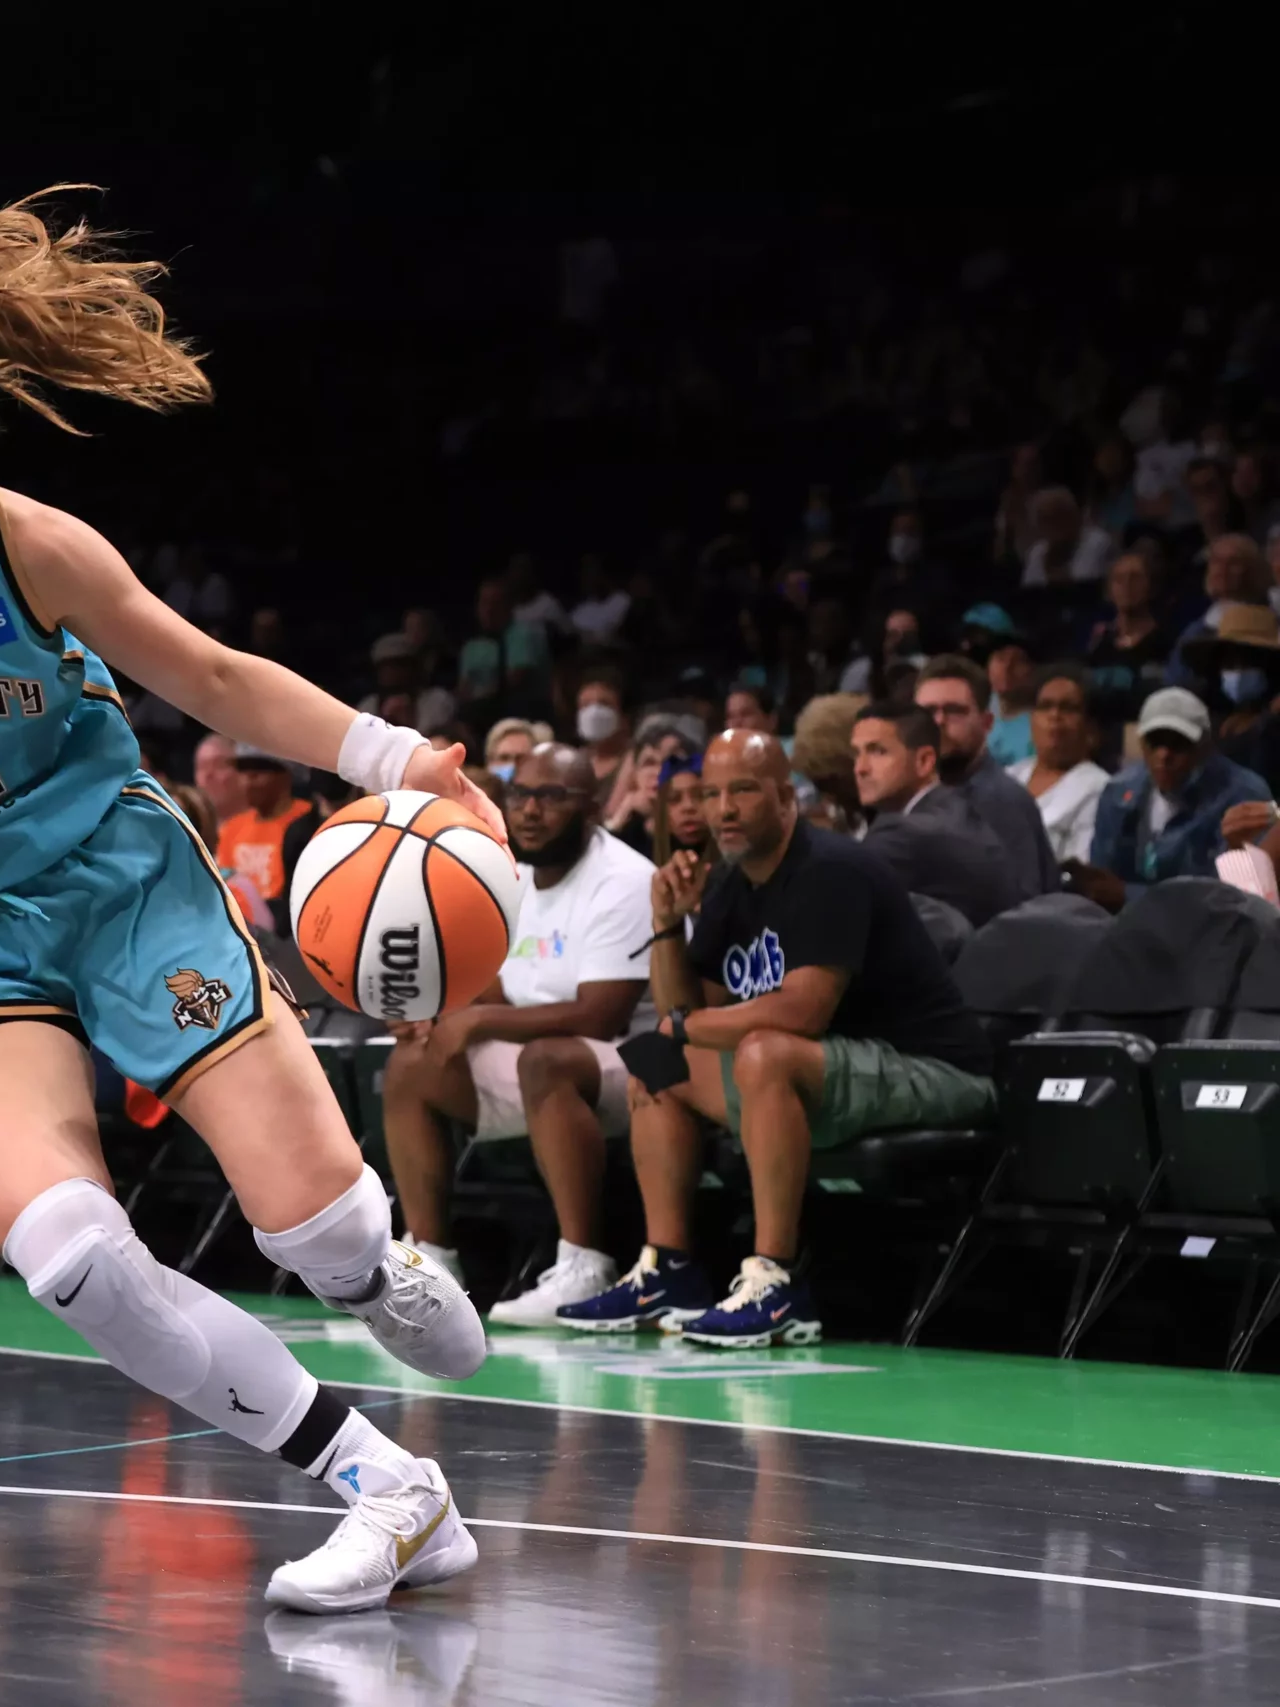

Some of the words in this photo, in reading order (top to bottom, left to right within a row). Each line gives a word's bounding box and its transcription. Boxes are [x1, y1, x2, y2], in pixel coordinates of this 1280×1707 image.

[380, 923, 421, 1021] Wilso
[1052, 1081, 1071, 1098] 52
[1211, 1087, 1231, 1105] 53
